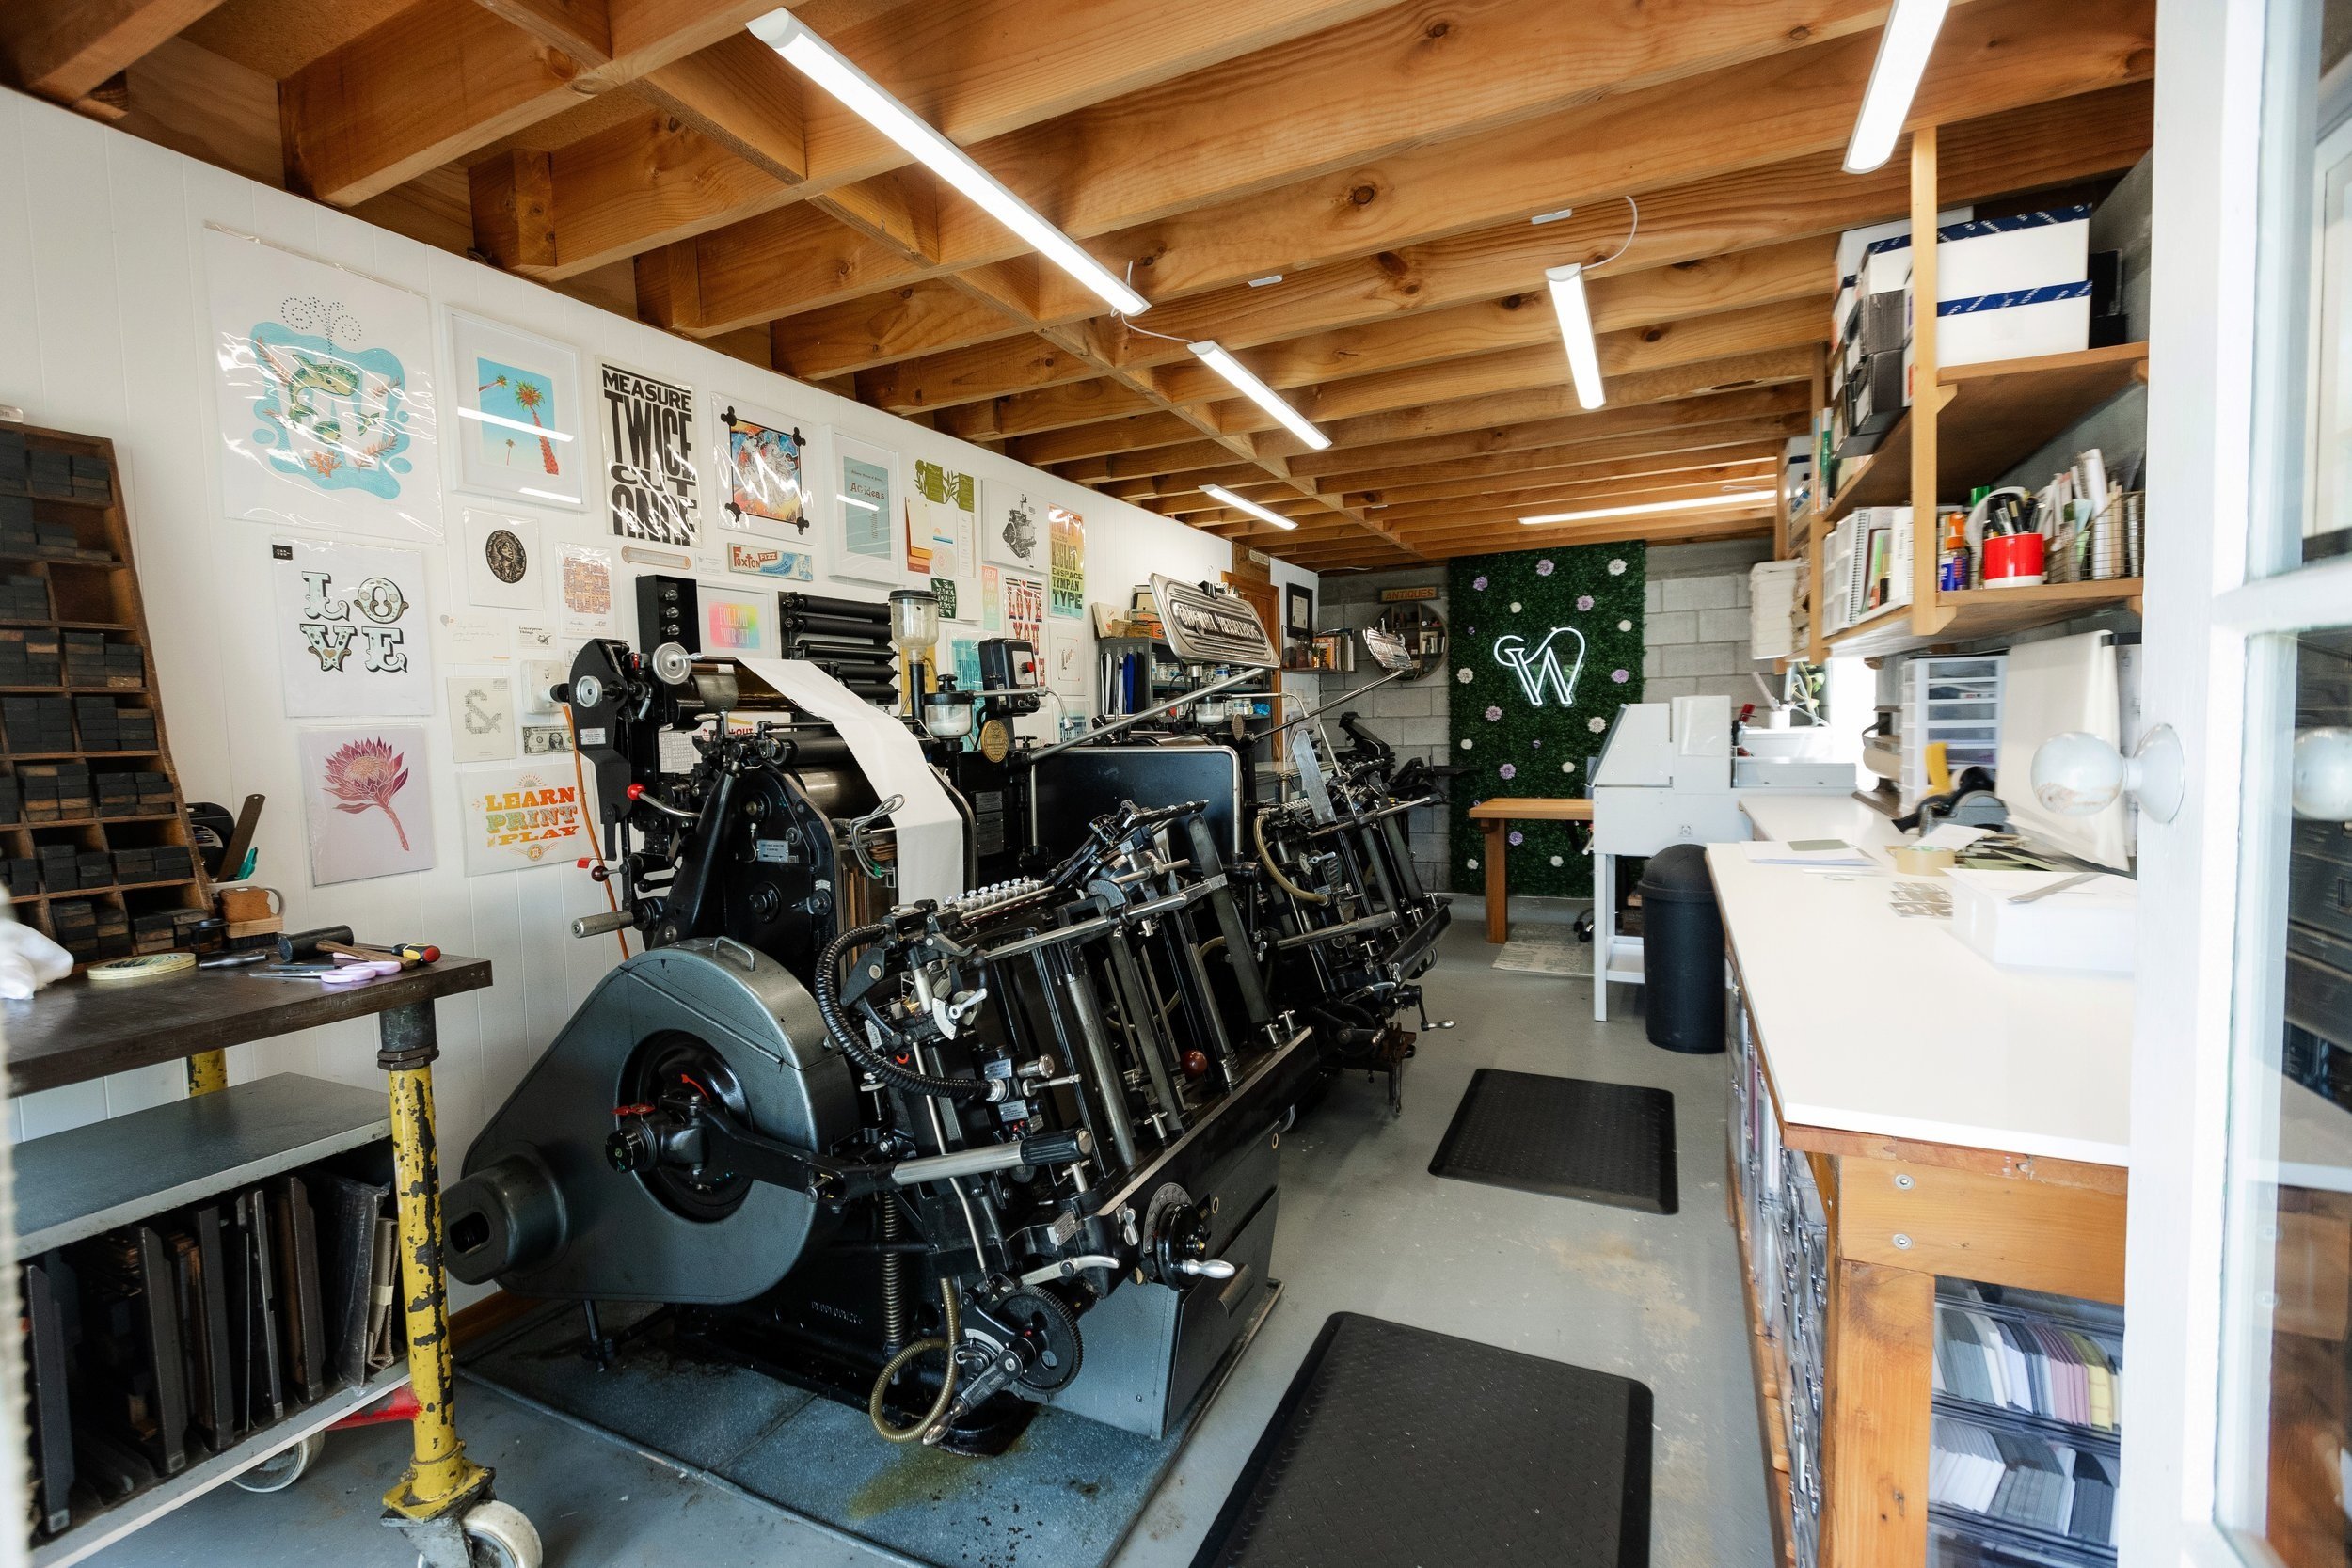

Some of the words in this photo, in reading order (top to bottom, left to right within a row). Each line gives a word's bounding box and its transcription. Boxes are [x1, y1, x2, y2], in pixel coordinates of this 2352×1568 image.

[601, 369, 692, 413] MEASURE
[604, 388, 697, 483] TWICE
[610, 465, 697, 498] CUT
[612, 483, 698, 547] ONCE
[759, 552, 777, 561] FIZZ
[1052, 568, 1083, 580] ENSPACE
[1052, 576, 1080, 592] TYMPAN
[1052, 589, 1083, 610] TYPE
[1386, 588, 1434, 601] ANTIQUES
[485, 786, 575, 812] LEARN
[485, 805, 579, 833] PRINT
[498, 825, 580, 846] PLAY
